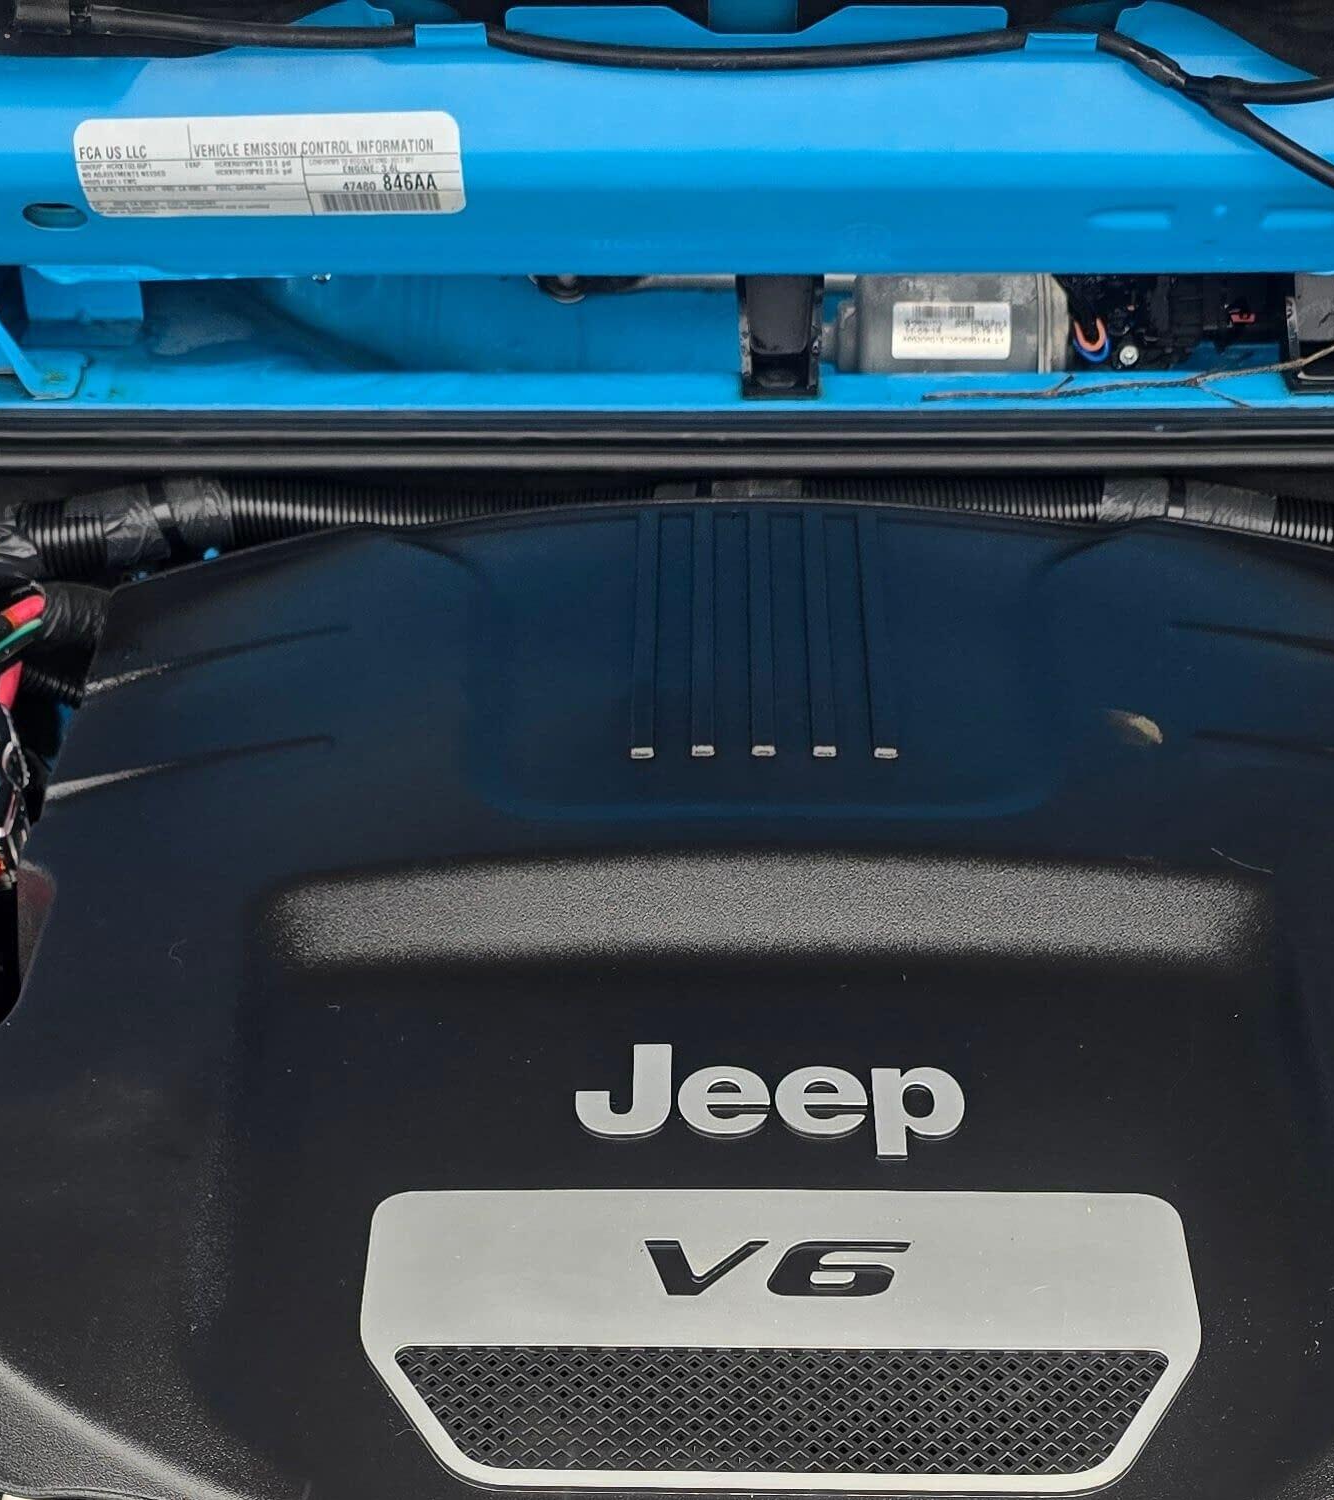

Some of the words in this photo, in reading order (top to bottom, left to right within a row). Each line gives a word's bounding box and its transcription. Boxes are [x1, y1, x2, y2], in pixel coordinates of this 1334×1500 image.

[79, 147, 101, 160] FCA
[106, 146, 121, 159] US
[126, 145, 147, 159] LLC
[194, 143, 240, 158] VEHICLE
[244, 141, 297, 157] EMISSION
[301, 140, 353, 155] CONTROL
[357, 138, 435, 154] INFORMATION
[383, 173, 438, 191] 846AA
[575, 1043, 966, 1160] Jeep
[643, 1239, 913, 1297] V6
